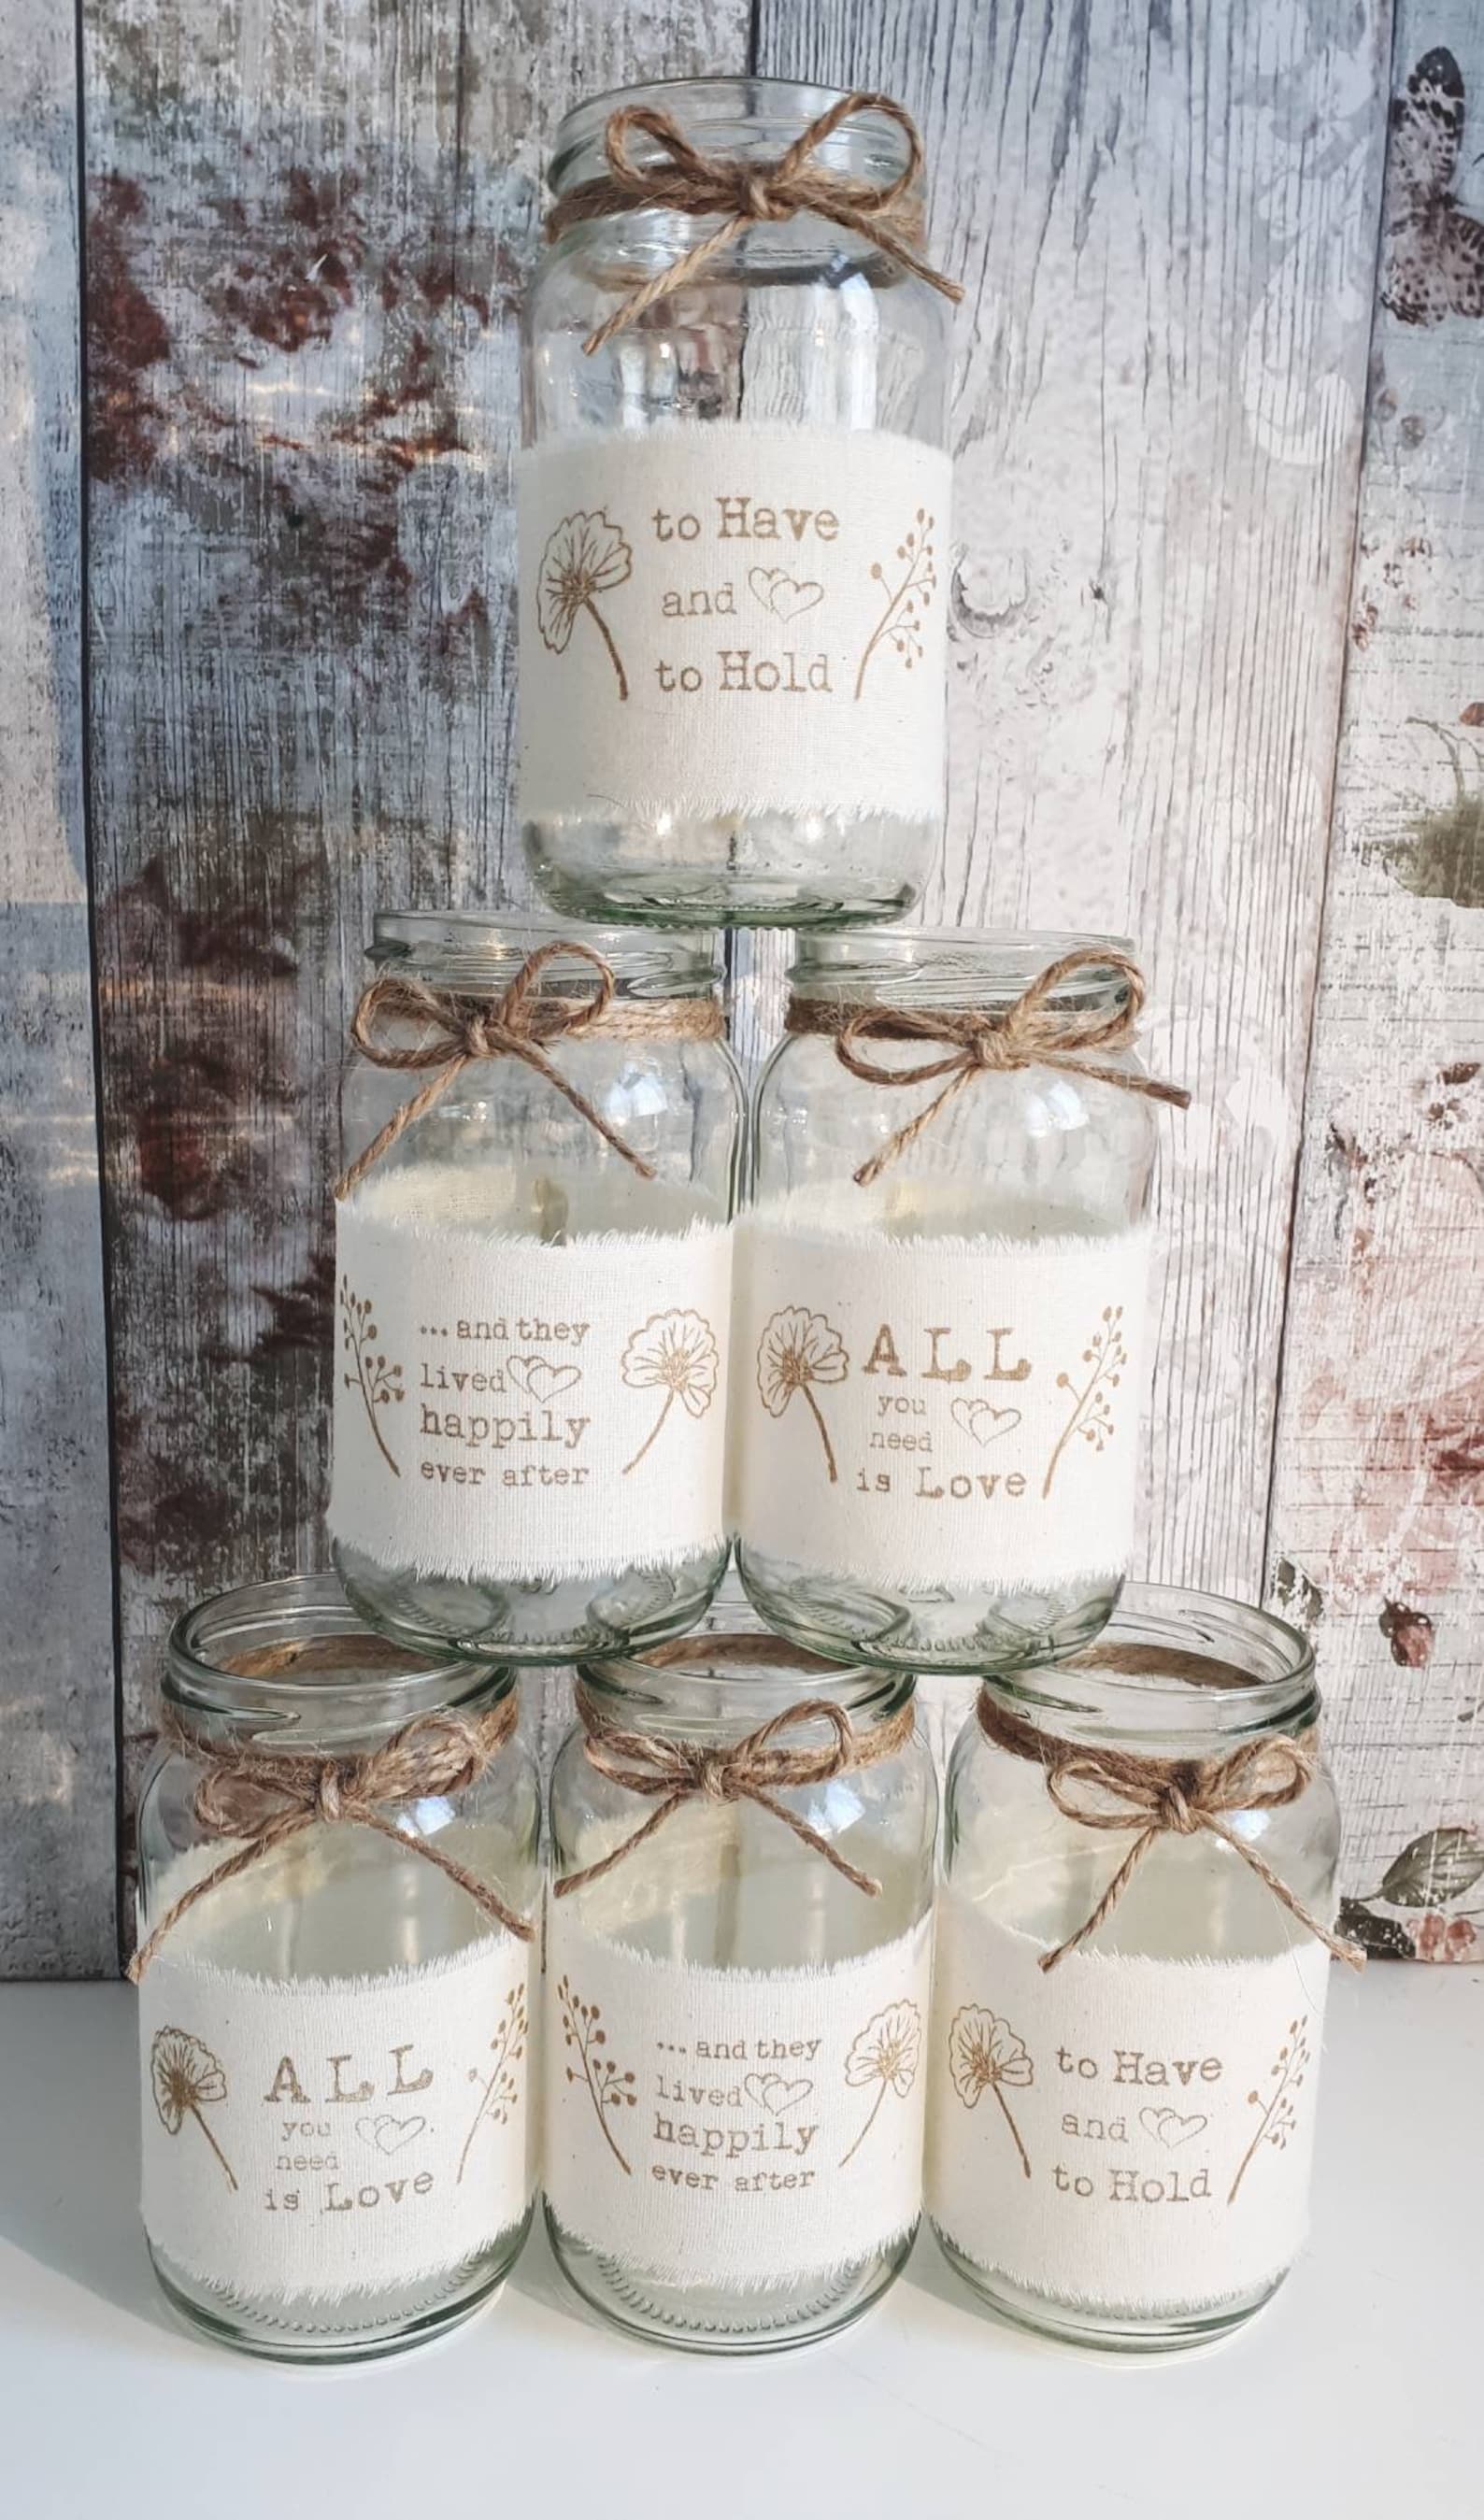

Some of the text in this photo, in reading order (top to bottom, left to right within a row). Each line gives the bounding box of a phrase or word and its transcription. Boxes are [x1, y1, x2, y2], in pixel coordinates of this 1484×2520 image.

[650, 496, 840, 542] to Have
[661, 582, 737, 618] and
[653, 649, 834, 692] to Hold
[516, 1317, 592, 1346] they
[862, 1323, 1033, 1383] ALL
[420, 1362, 508, 1393] lived
[878, 1393, 927, 1417] you
[419, 1402, 592, 1449] happily
[868, 1429, 934, 1453] need
[420, 1460, 590, 1487] ever after
[856, 1465, 1028, 1500] is Love
[755, 2038, 822, 2061] they
[1055, 2045, 1224, 2087] to Have
[263, 2043, 435, 2104] ALL
[656, 2074, 744, 2108] lived
[280, 2121, 333, 2142] you
[652, 2112, 820, 2159] happily
[1061, 2113, 1130, 2143] and
[275, 2151, 340, 2171] need
[651, 2164, 817, 2192] ever after
[264, 2171, 435, 2212] is Love
[1051, 2161, 1212, 2203] to Hold
